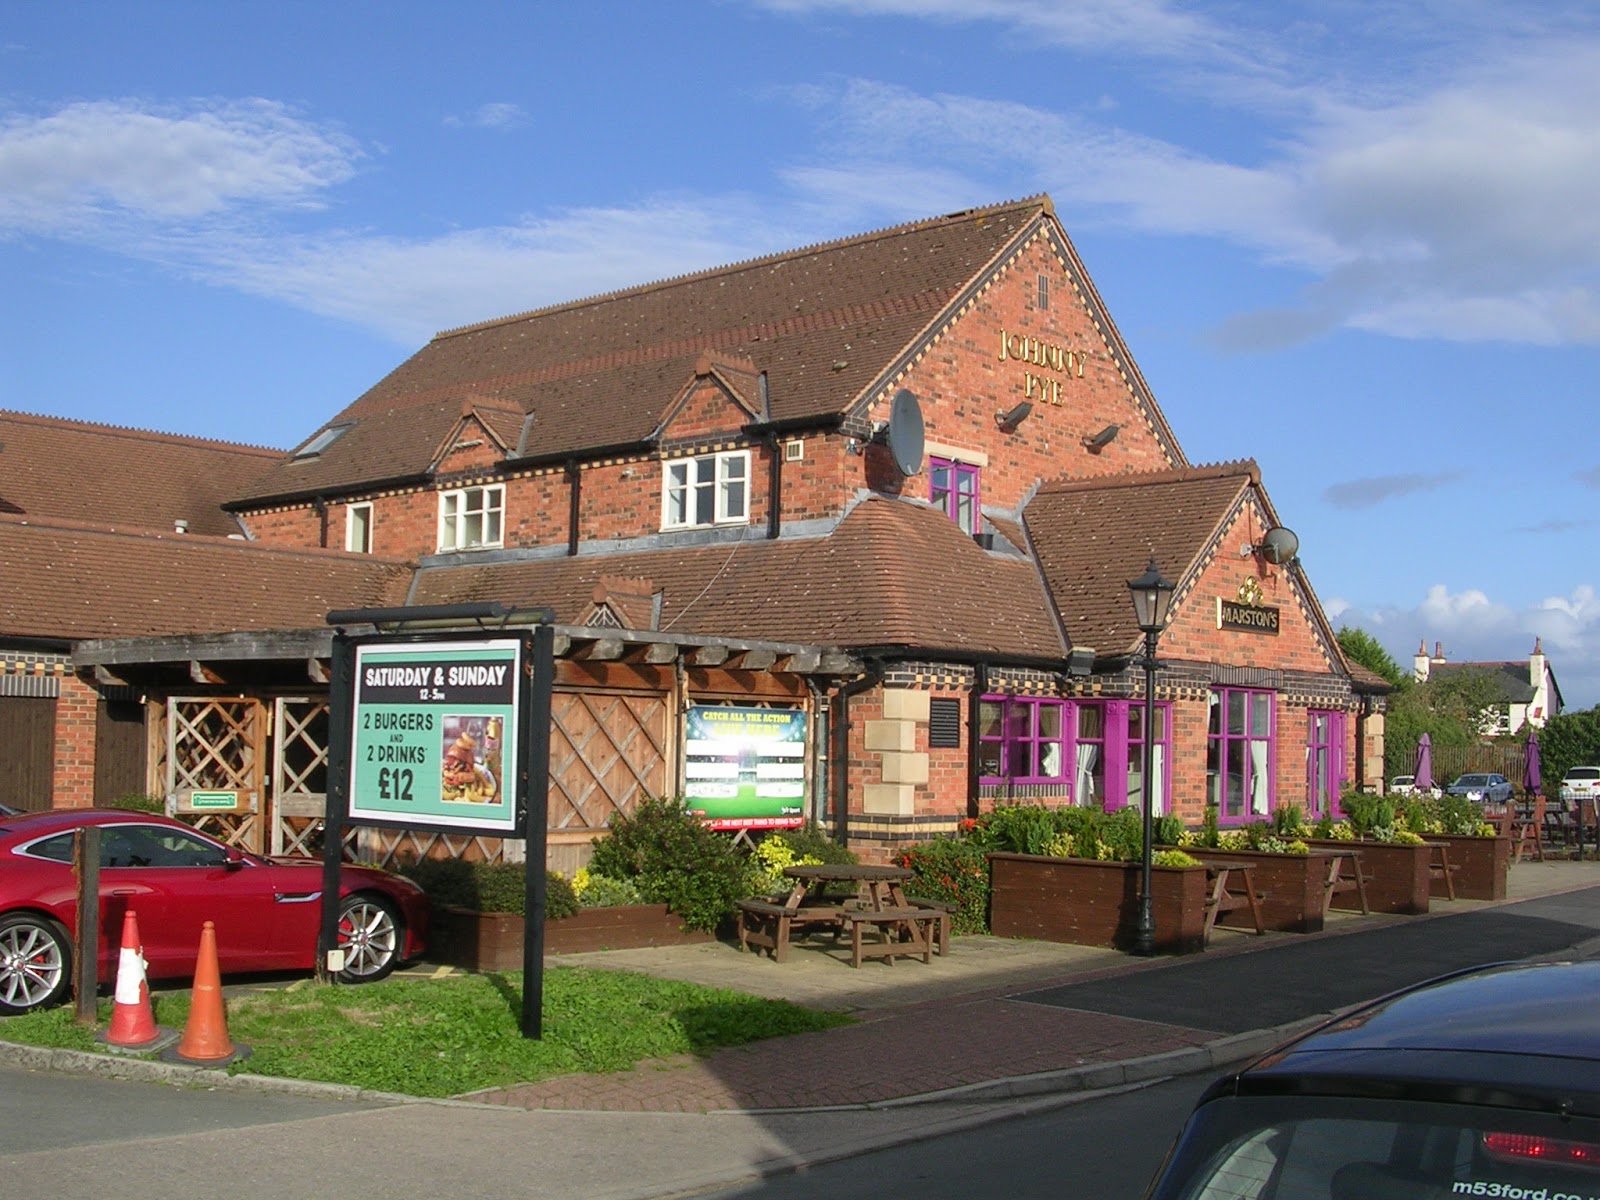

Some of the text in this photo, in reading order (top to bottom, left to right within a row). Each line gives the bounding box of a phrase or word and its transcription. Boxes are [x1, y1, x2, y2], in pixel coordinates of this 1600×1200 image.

[998, 327, 1088, 379] JOHNNY
[1025, 370, 1065, 407] PYE
[365, 665, 507, 687] SATURDAY & SUNDAY
[364, 713, 433, 731] 2 BURGERS
[702, 711, 791, 724] CATCH ALL THE ACTION
[389, 733, 404, 744] AND
[367, 745, 374, 762] 2
[378, 767, 413, 801] £12
